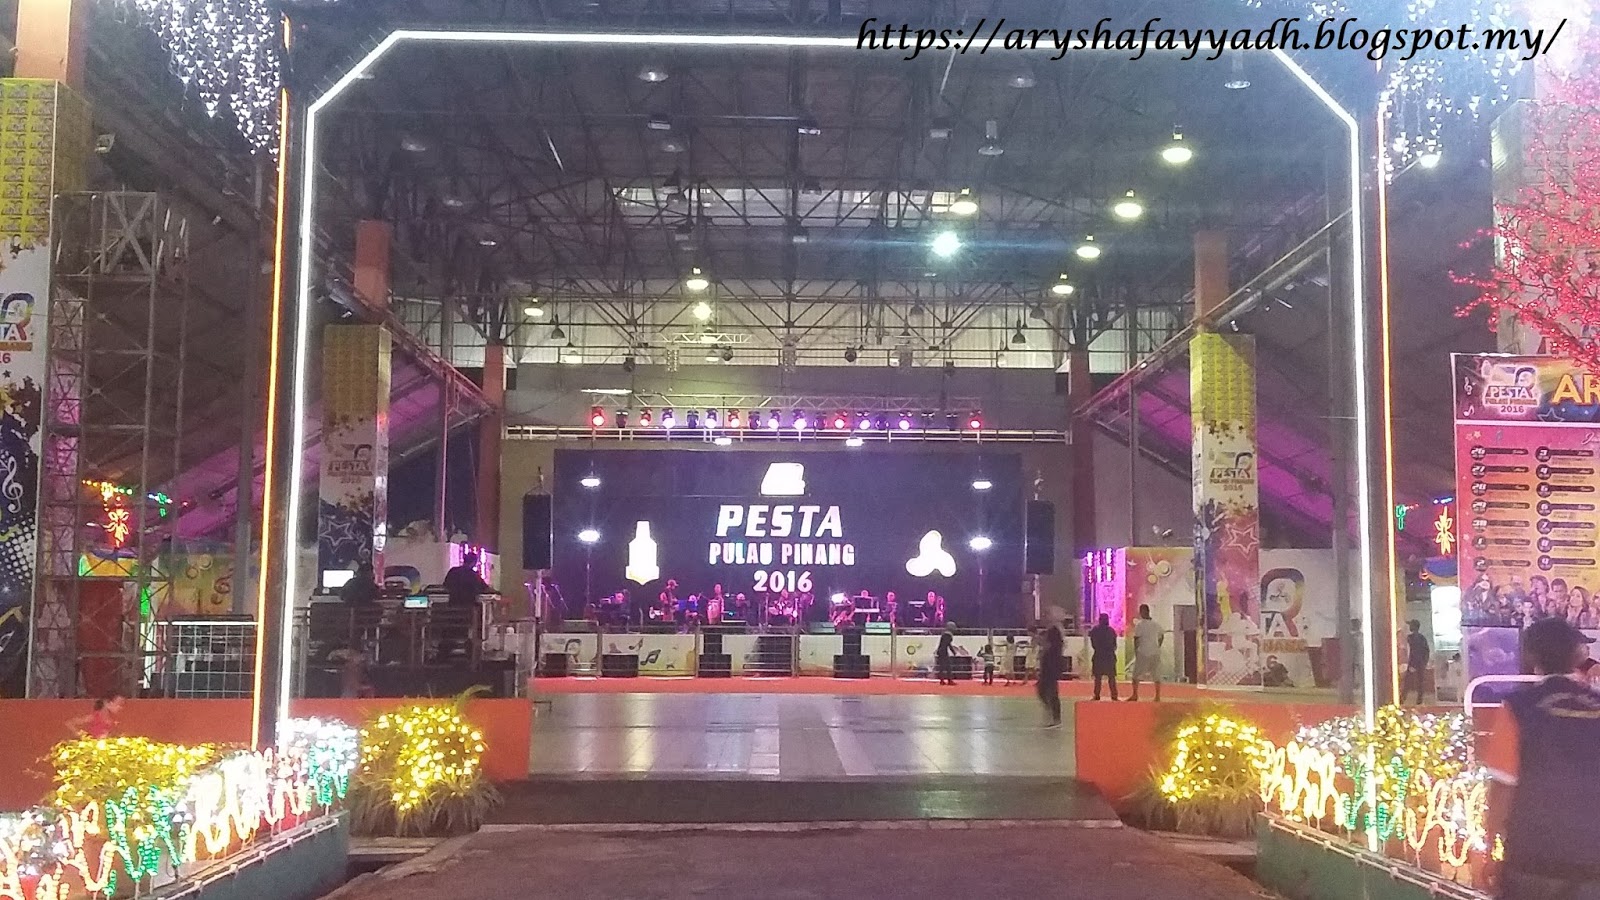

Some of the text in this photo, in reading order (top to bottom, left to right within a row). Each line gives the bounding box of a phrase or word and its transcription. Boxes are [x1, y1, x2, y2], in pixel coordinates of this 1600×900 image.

[1488, 386, 1531, 399] PESTA
[1500, 405, 1525, 413] 2016
[715, 504, 843, 538] PESTA
[708, 542, 855, 566] PULAU PINANG
[752, 570, 813, 593] 2016
